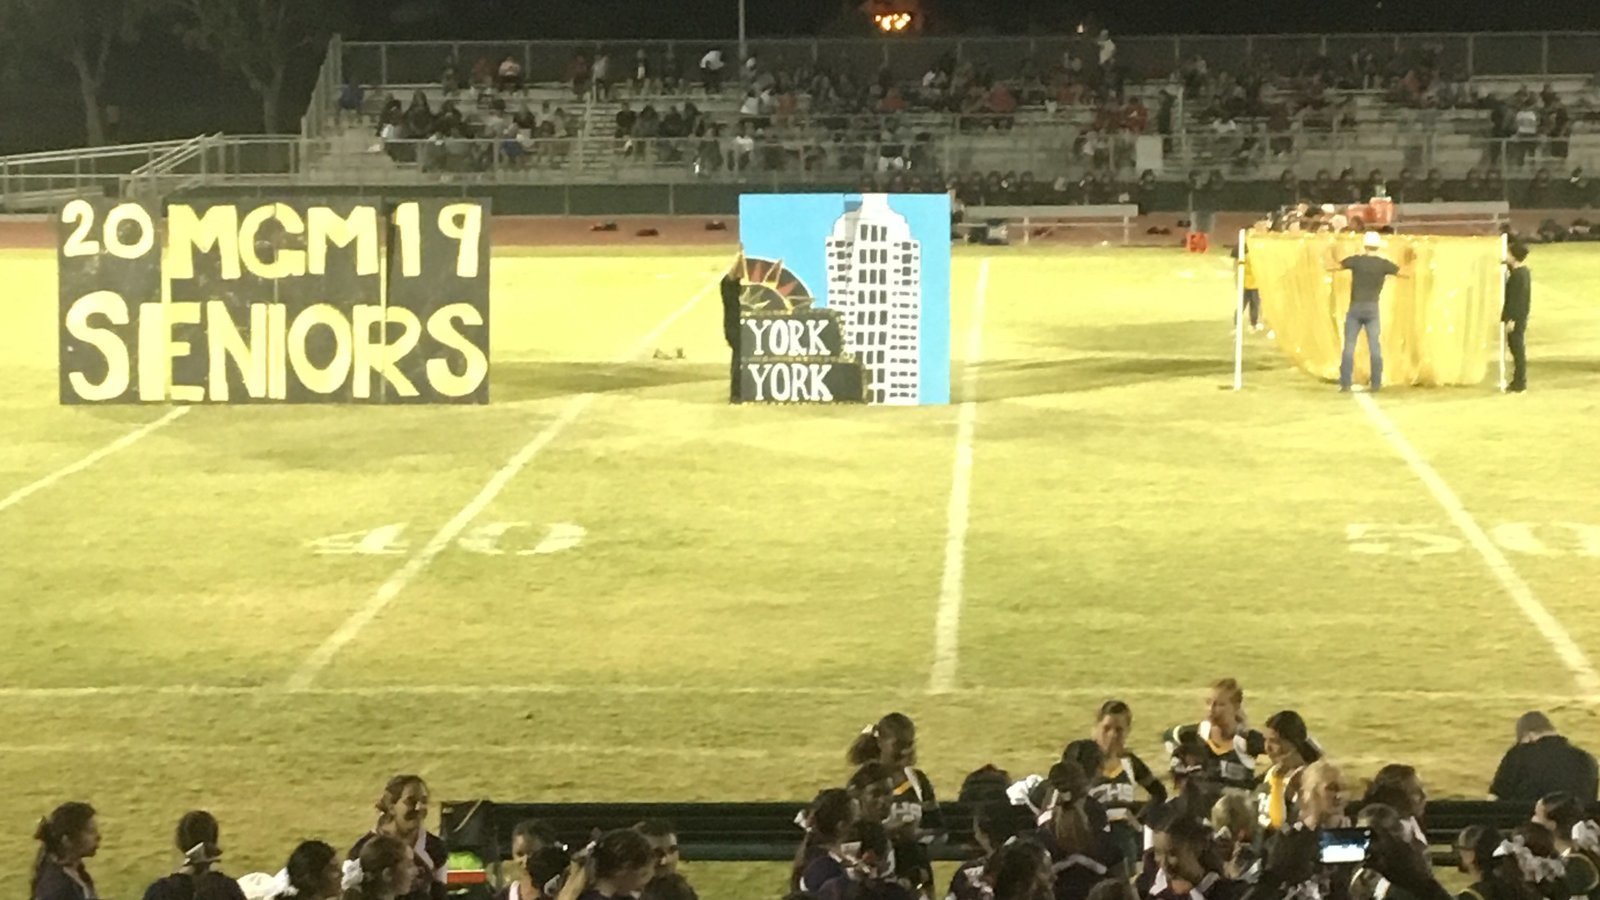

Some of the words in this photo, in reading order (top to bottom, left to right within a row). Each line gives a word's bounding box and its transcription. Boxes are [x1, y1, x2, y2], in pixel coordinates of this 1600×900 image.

[62, 199, 154, 259] 20
[167, 202, 381, 280] MGM
[393, 202, 483, 278] 19
[65, 290, 488, 402] SENIORS
[746, 318, 832, 357] YORK
[747, 362, 834, 402] YORK
